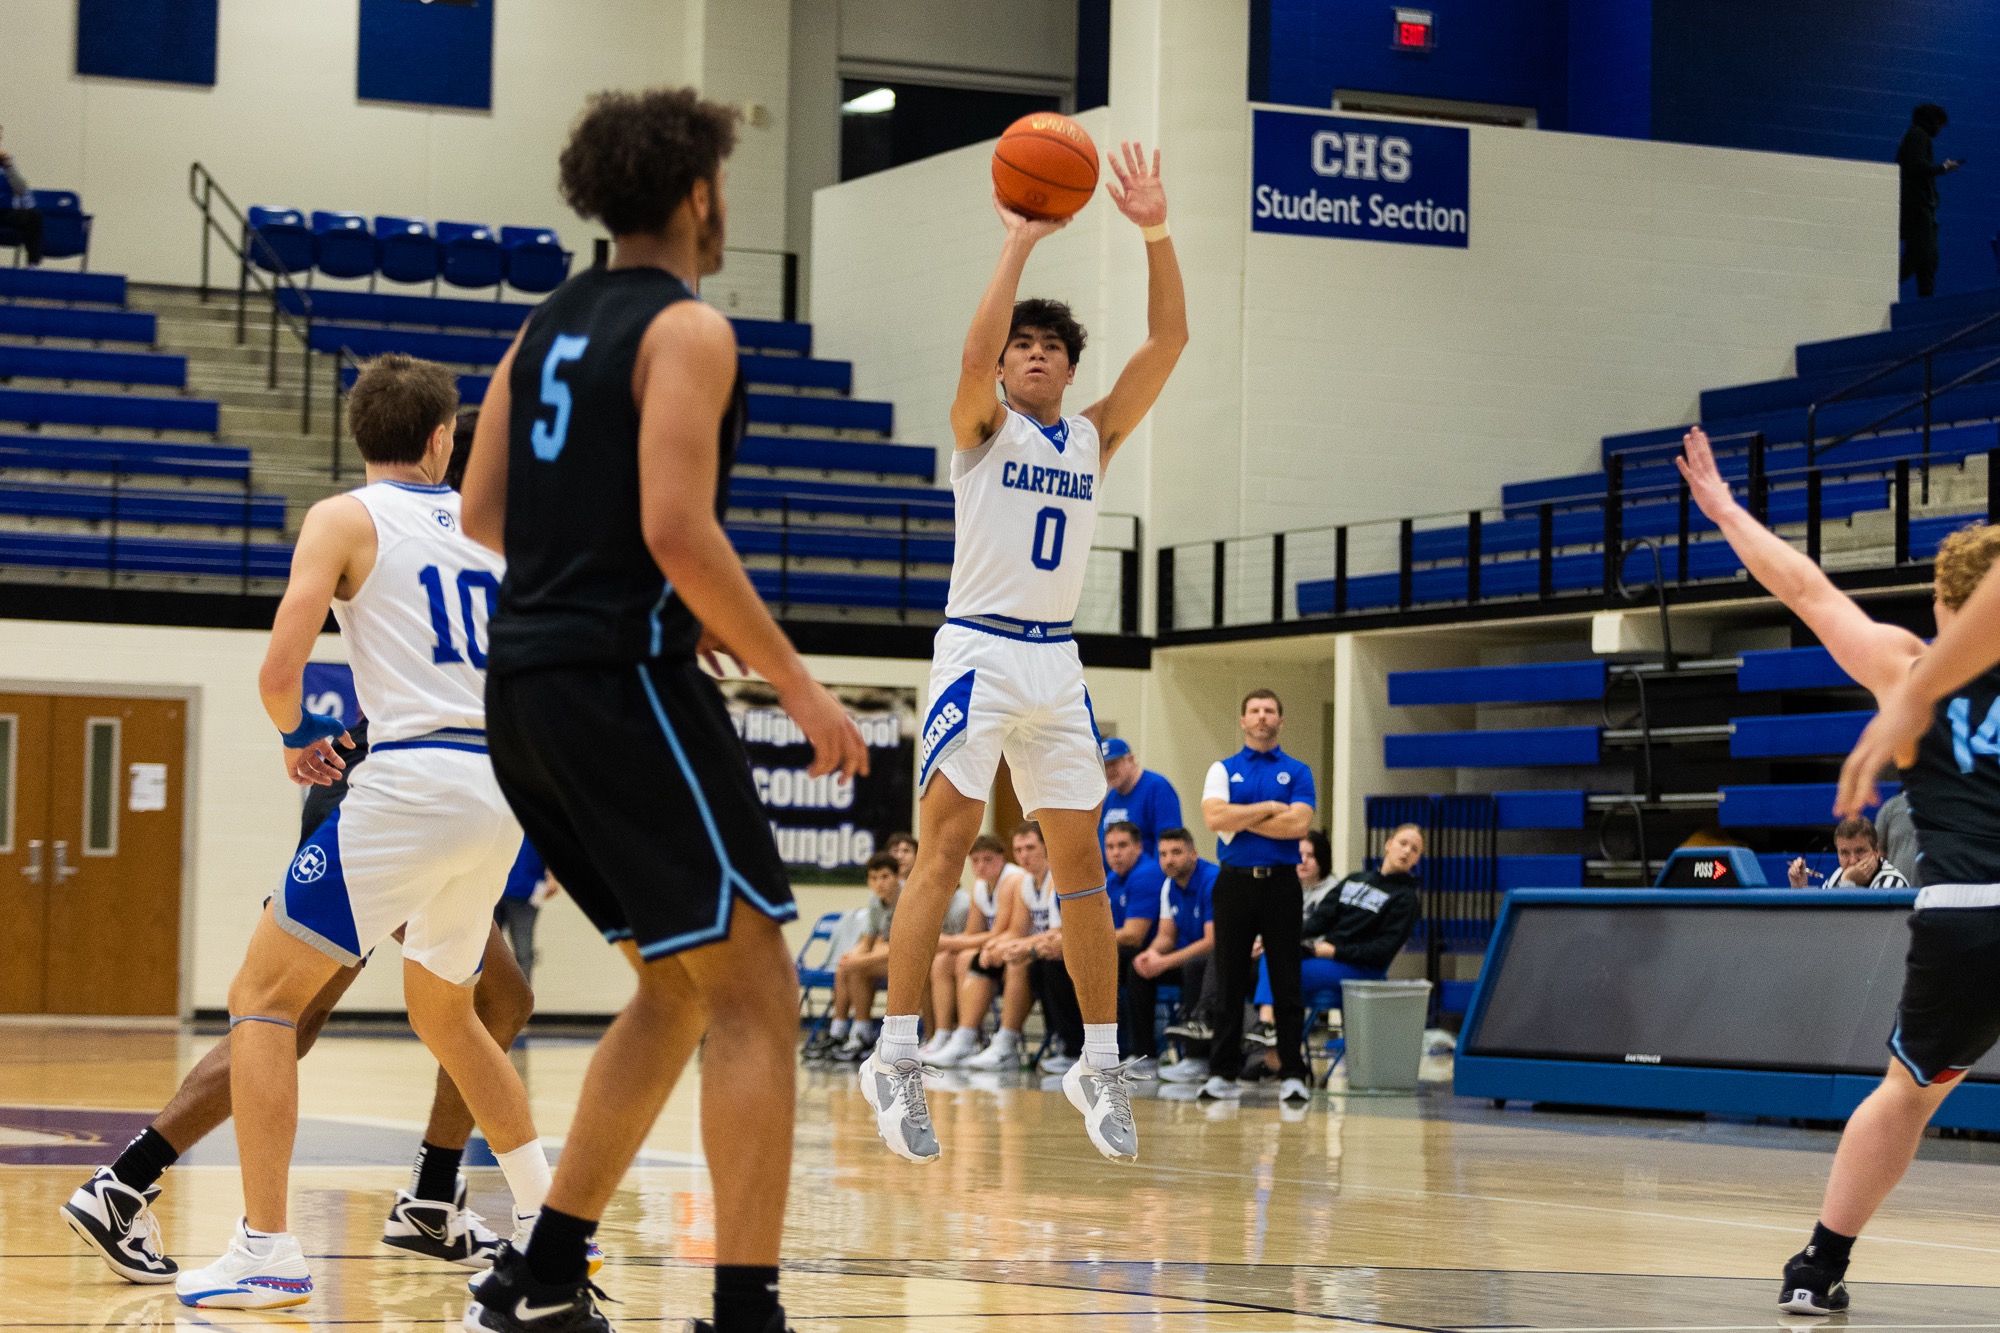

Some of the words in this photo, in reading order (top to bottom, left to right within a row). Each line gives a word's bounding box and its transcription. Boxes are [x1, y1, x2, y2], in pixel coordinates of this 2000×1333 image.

[1311, 130, 1412, 183] CHS
[1256, 184, 1362, 226] Student
[1368, 193, 1467, 234] Section
[531, 332, 590, 462] 5
[1002, 460, 1094, 502] CARTHAGE
[1031, 505, 1067, 572] 0
[418, 563, 500, 670] 10
[857, 714, 900, 748] ool
[920, 701, 964, 770] GERS
[1946, 694, 2000, 775] 14
[752, 766, 855, 810] come
[769, 819, 875, 870] ungle
[1693, 861, 1714, 878] POSS
